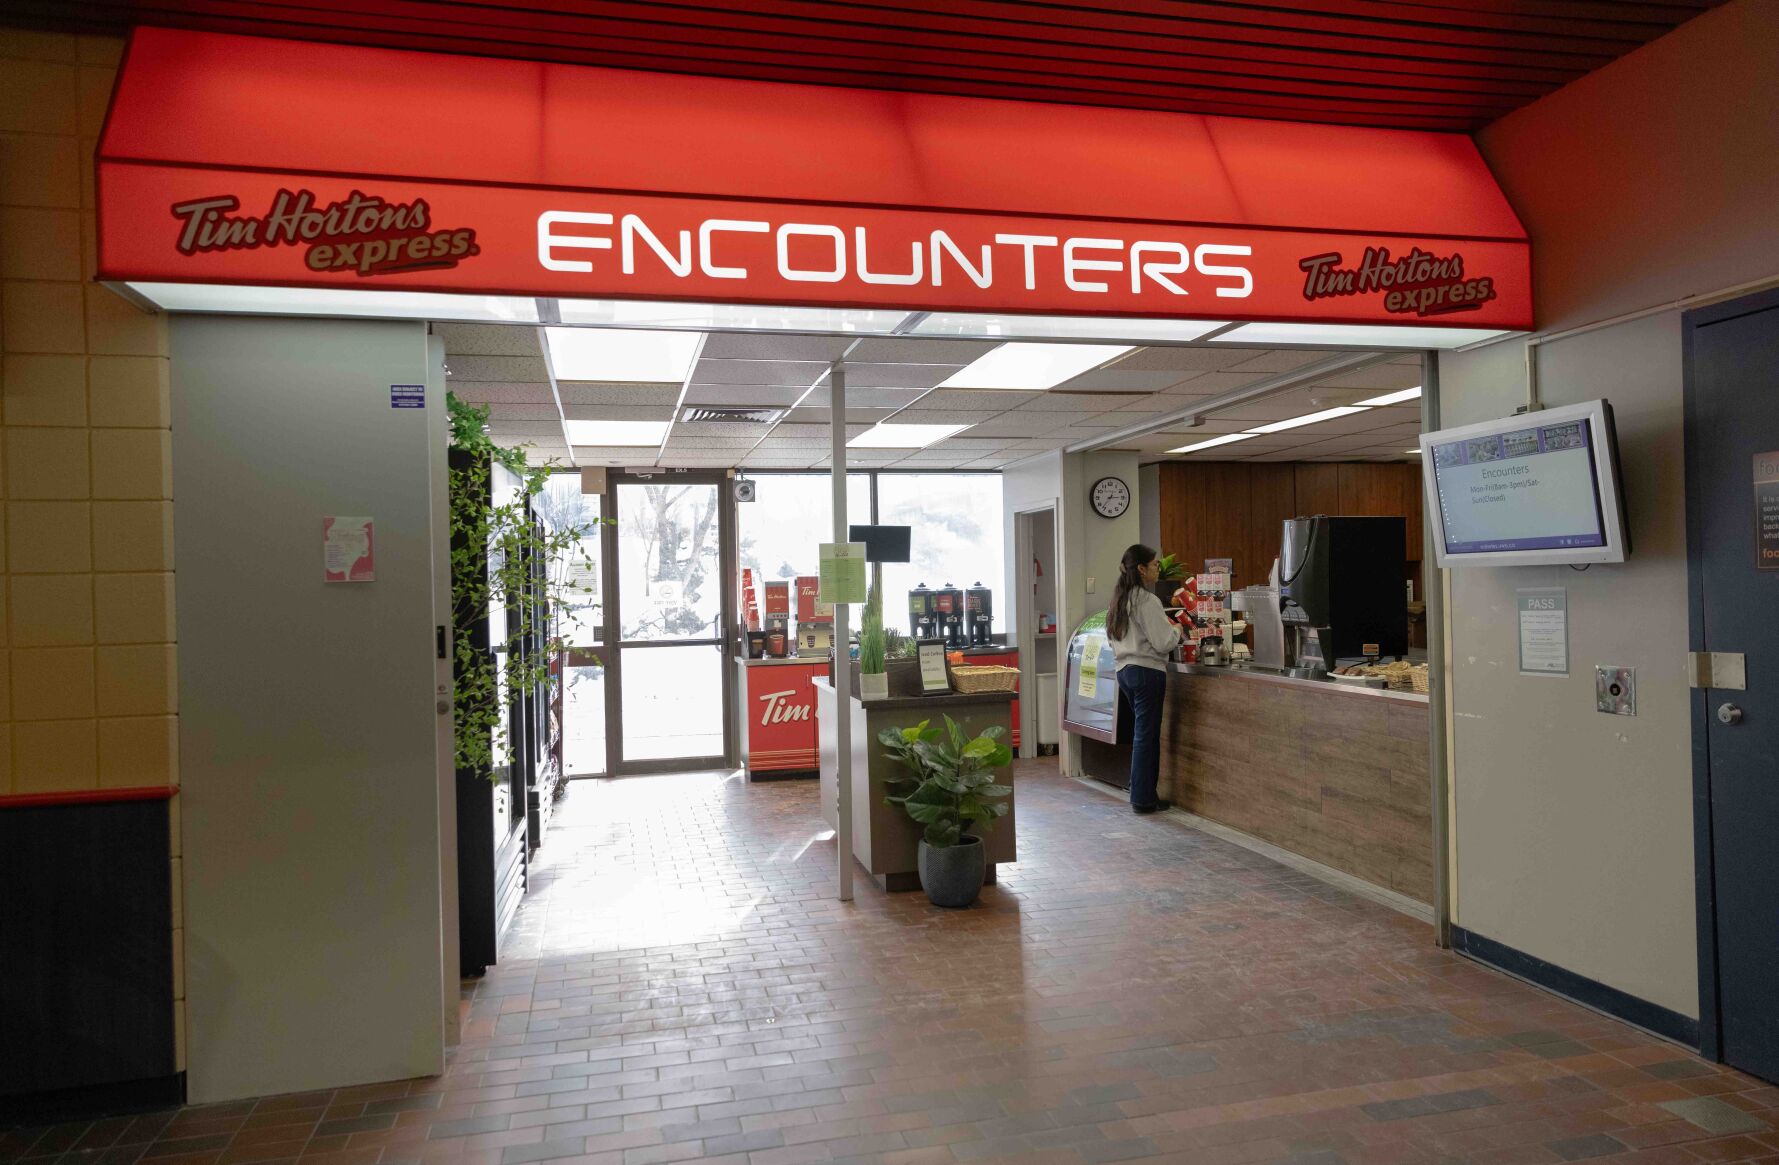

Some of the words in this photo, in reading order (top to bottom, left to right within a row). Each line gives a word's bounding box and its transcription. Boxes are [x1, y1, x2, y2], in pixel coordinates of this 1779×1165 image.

[175, 199, 258, 250] Tim
[265, 192, 425, 242] Hortons
[308, 231, 471, 272] express
[537, 210, 1253, 298] ENCOUNTERS
[1302, 255, 1353, 297] Tim
[1358, 249, 1461, 290] Hortons
[1386, 279, 1490, 313] express
[1481, 465, 1530, 479] Encounters
[1528, 599, 1555, 609] PASS
[760, 689, 811, 727] Tim
